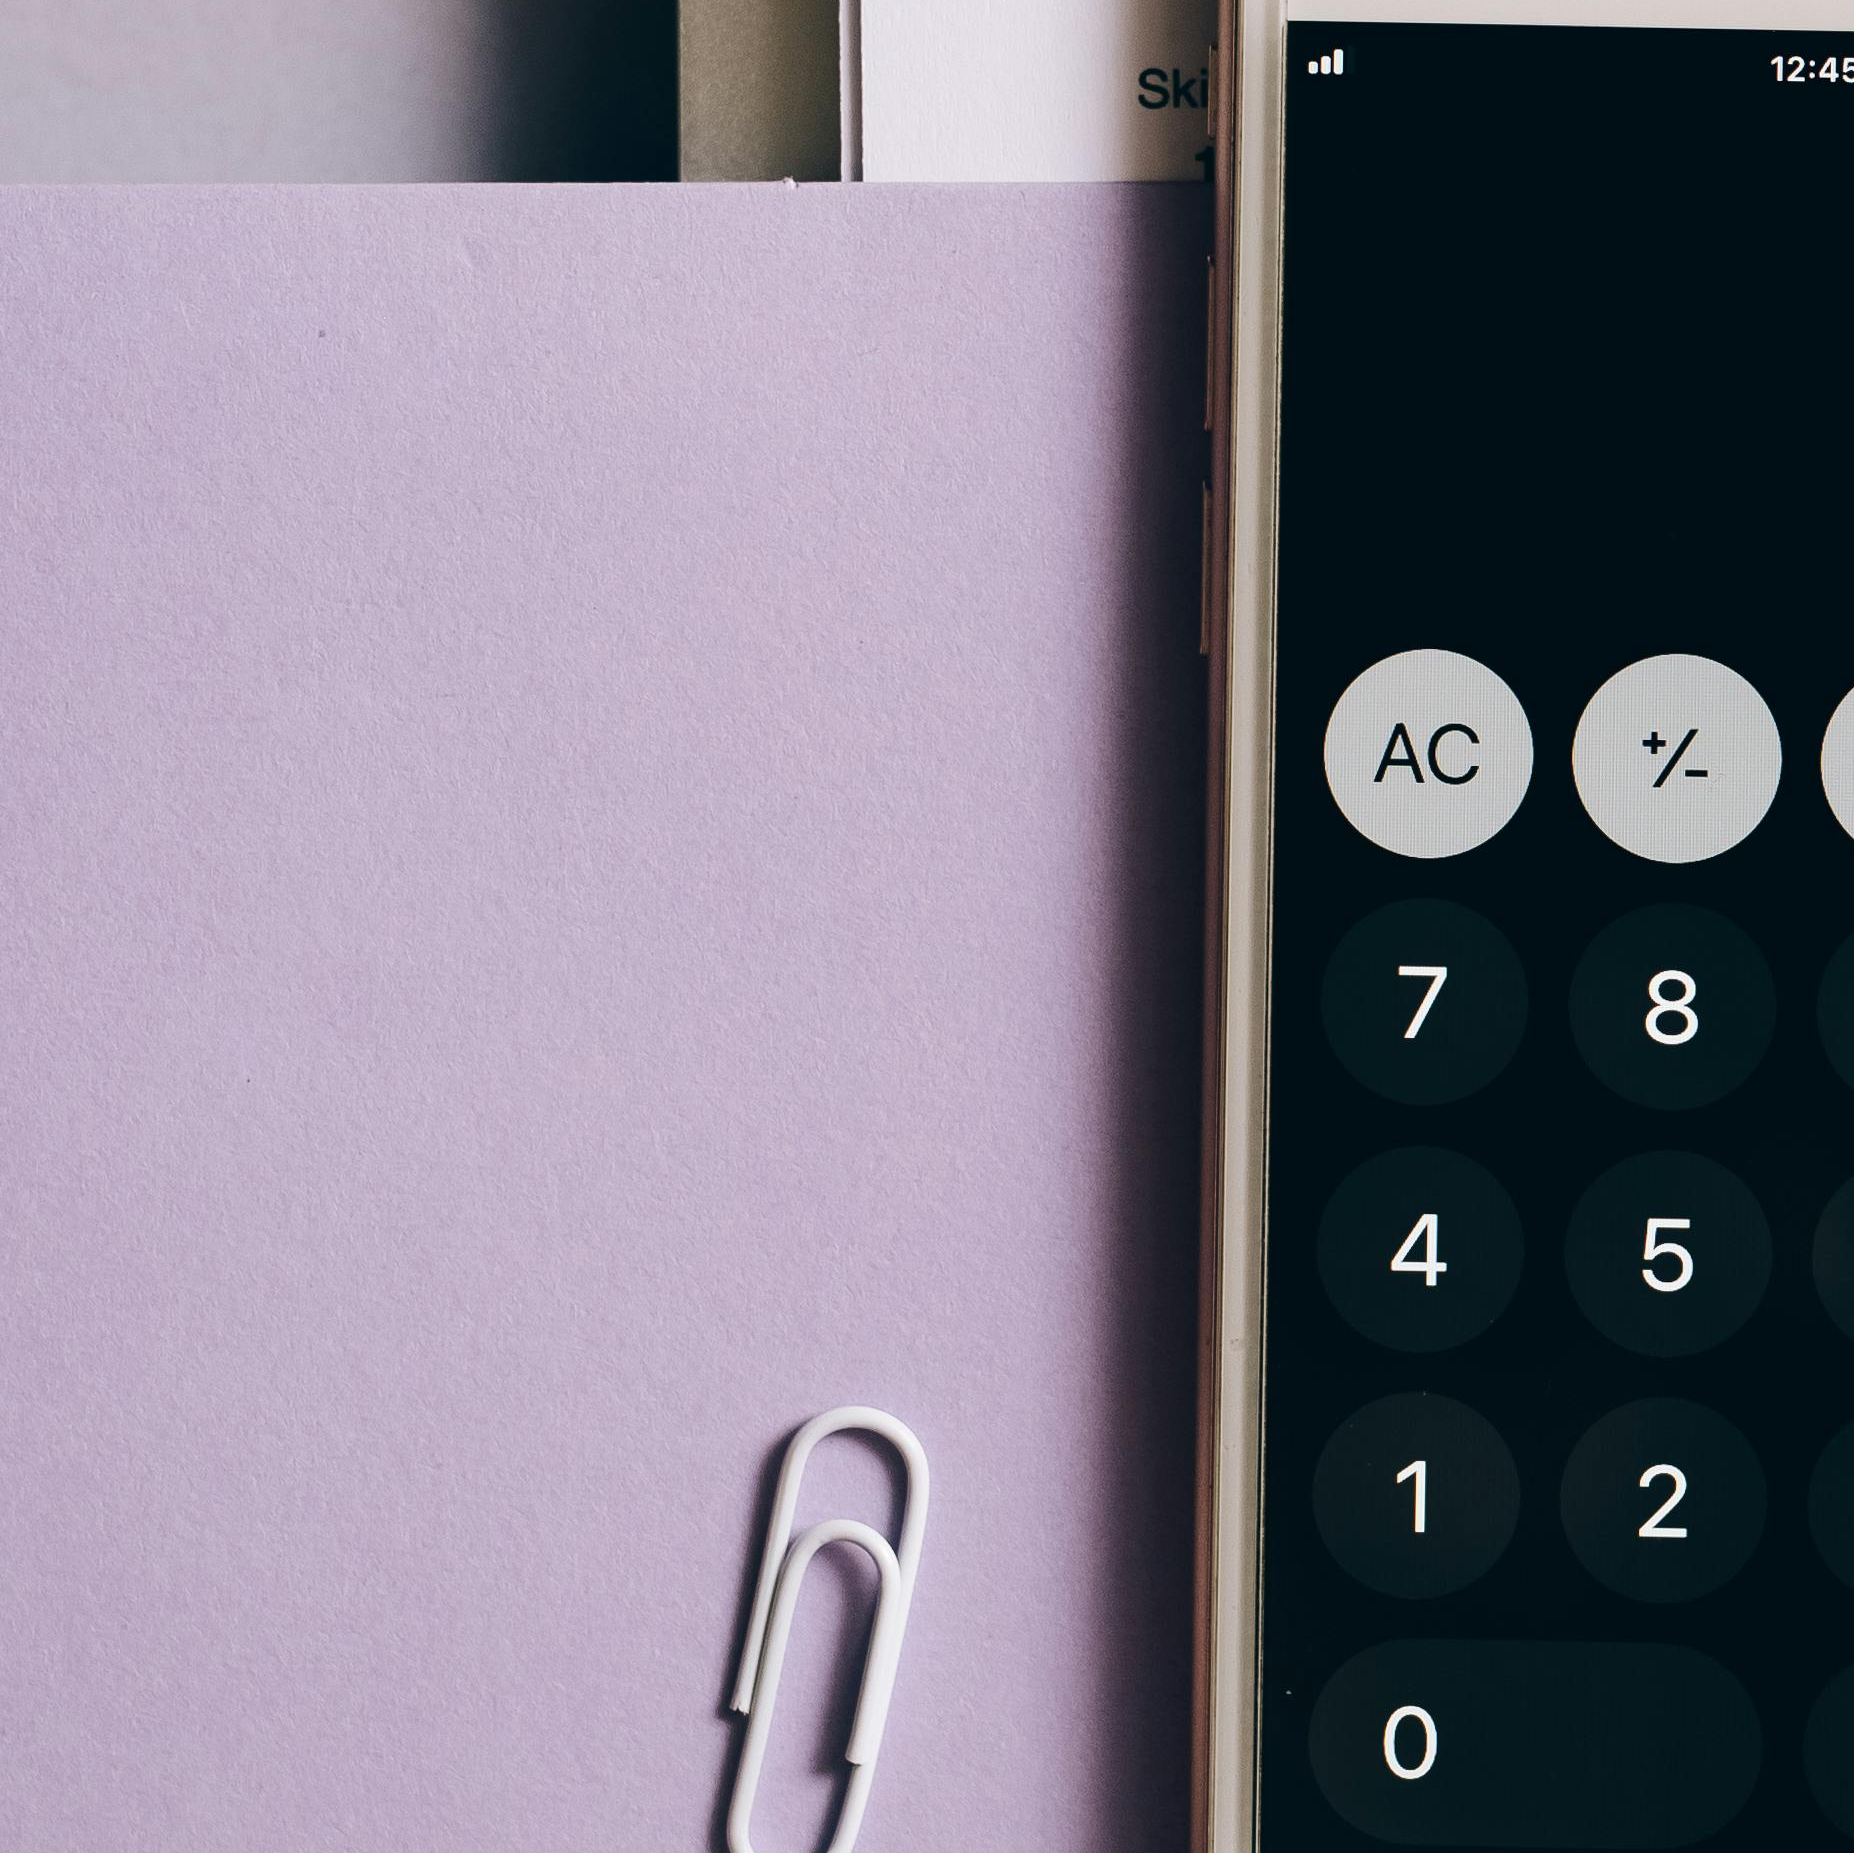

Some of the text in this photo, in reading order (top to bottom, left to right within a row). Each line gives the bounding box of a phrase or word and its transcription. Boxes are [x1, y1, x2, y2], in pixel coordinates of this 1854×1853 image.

[1374, 723, 1479, 784] AC
[1399, 966, 1447, 1038] 7
[1646, 970, 1698, 1044] 8
[1391, 1214, 1447, 1286] 4
[1643, 1218, 1693, 1291] 5
[1397, 1461, 1426, 1532] 1
[1639, 1464, 1687, 1537] 2
[1384, 1706, 1437, 1779] 0
